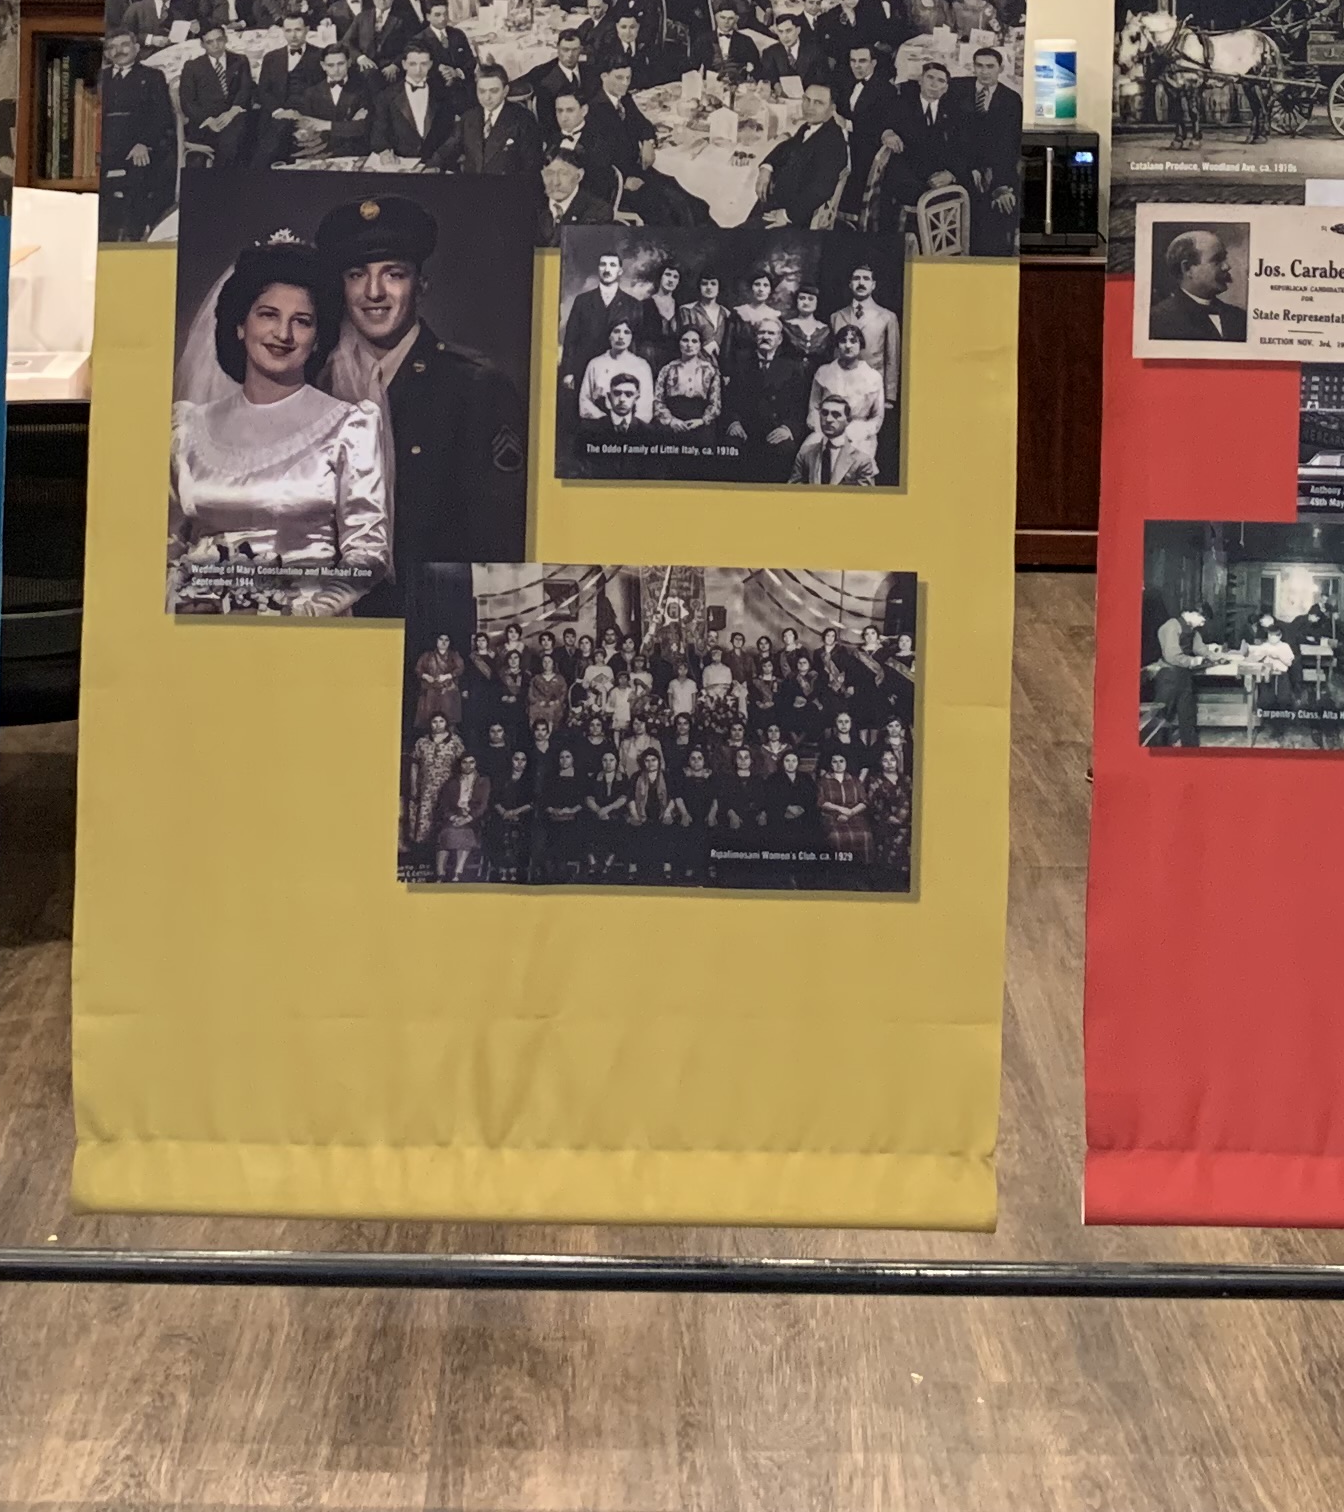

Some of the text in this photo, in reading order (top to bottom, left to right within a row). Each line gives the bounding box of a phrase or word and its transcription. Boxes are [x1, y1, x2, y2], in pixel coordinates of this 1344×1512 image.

[1130, 161, 1164, 172] Catalano
[1166, 162, 1200, 173] Produce,
[1202, 162, 1240, 172] Woodland
[1260, 164, 1272, 173] ca.
[1254, 258, 1285, 281] Jos.
[1270, 284, 1308, 294] REPUBLICAN
[1301, 295, 1315, 303] FOR
[1252, 308, 1280, 322] State
[1259, 337, 1295, 346] ELECTION
[1297, 339, 1315, 347] NOV.
[587, 444, 601, 454] The
[602, 444, 622, 454] Oddo
[623, 445, 648, 456] Family
[650, 445, 659, 454] of
[660, 445, 679, 455] Little
[702, 447, 714, 455] ca.
[716, 446, 739, 456] 1910s
[1310, 486, 1342, 496] Anthony
[1310, 496, 1327, 507] 49th
[192, 565, 373, 578] Wedding of Mary Constantino and Michael Zone
[192, 577, 254, 588] September 1944
[1257, 708, 1296, 720] Carpentry
[1322, 709, 1337, 720] Alta
[762, 850, 854, 862] Women's ca. 1929
